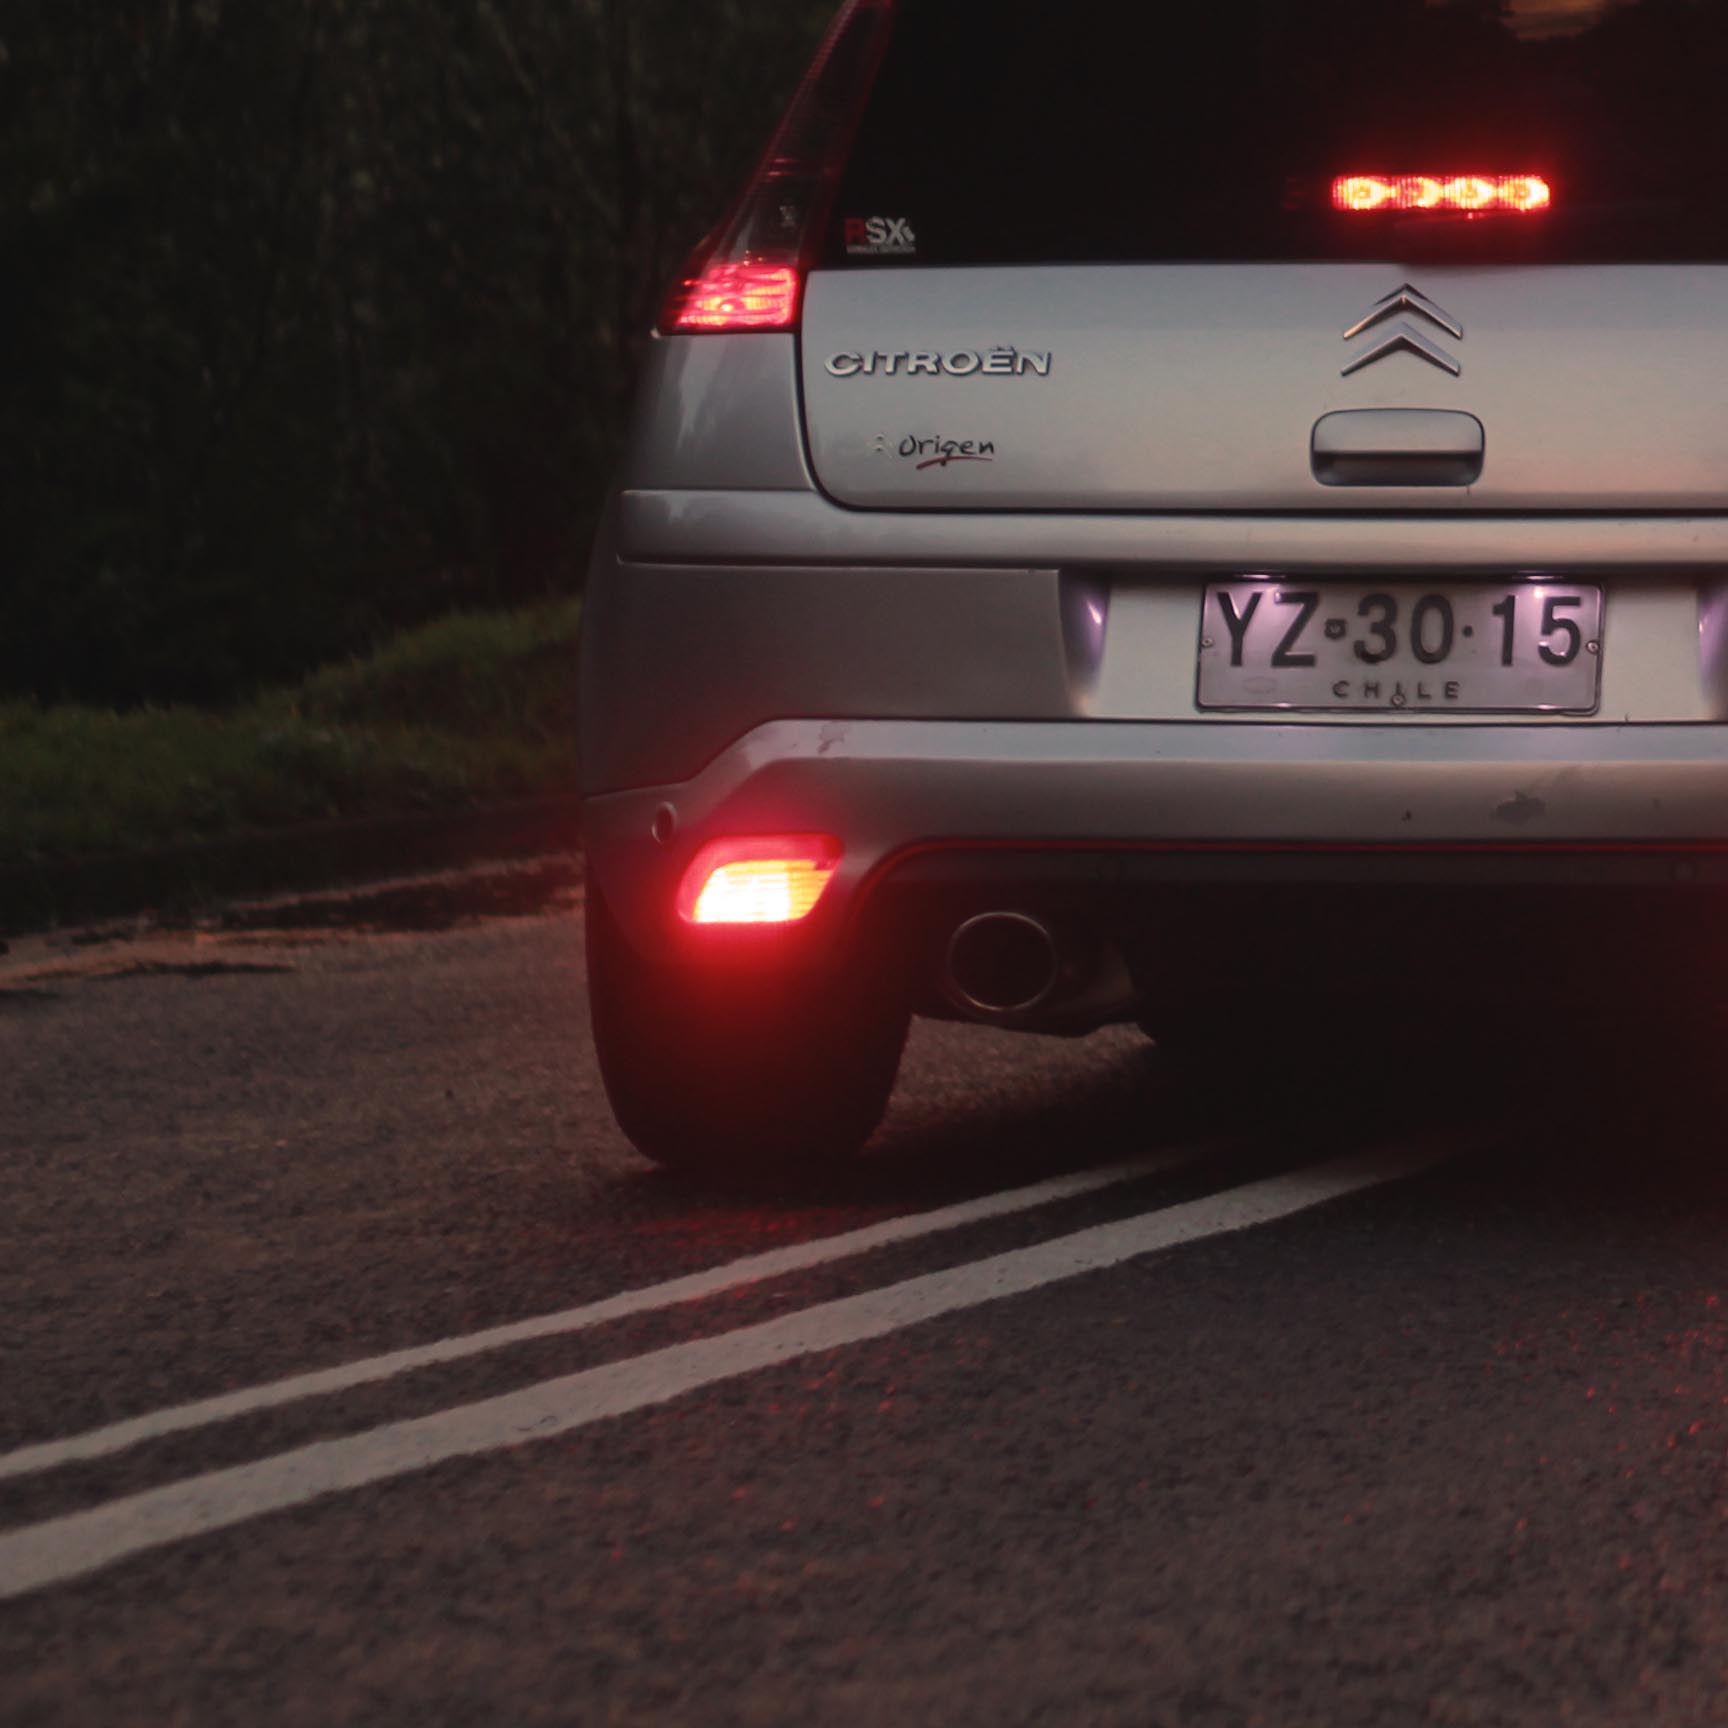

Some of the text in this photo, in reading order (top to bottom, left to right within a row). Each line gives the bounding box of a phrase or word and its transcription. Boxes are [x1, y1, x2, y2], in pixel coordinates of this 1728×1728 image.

[824, 344, 1052, 378] CITROËN
[898, 434, 995, 465] Origen
[1332, 680, 1461, 699] CHILE
